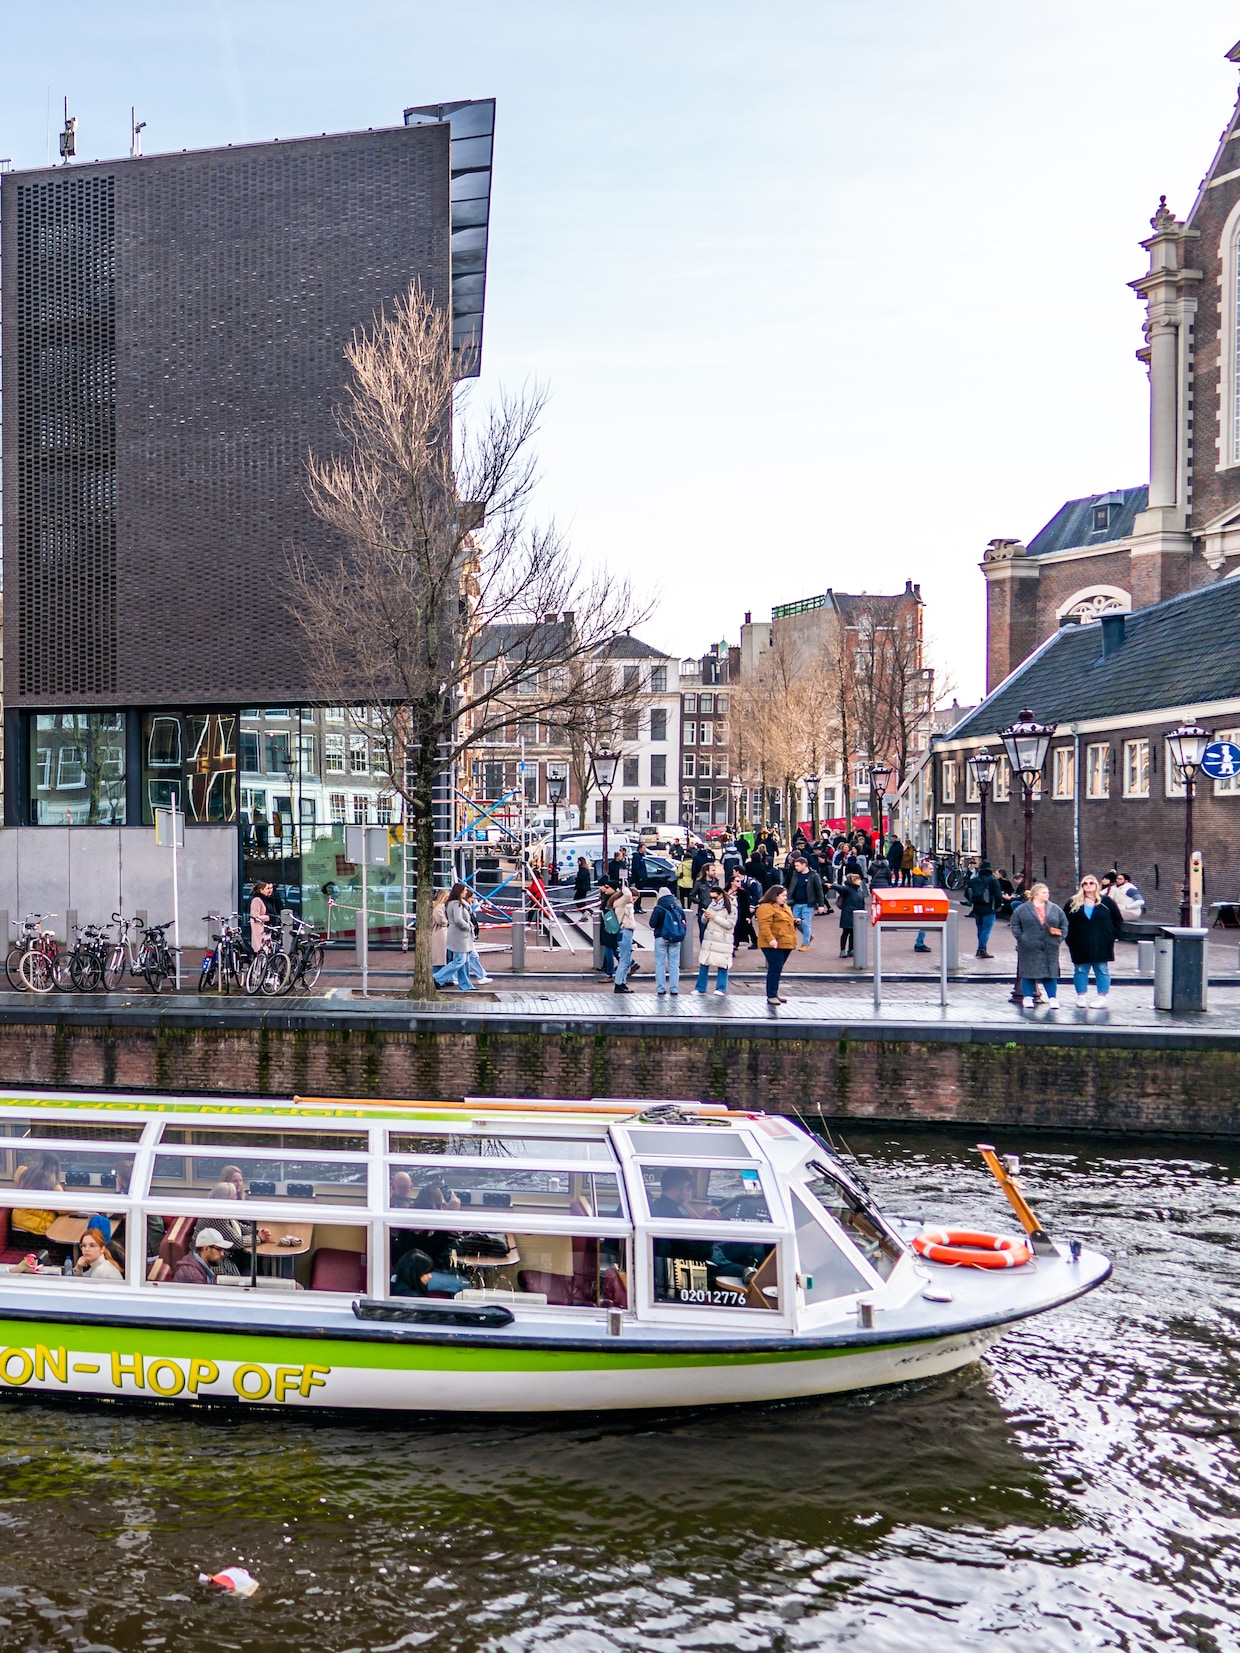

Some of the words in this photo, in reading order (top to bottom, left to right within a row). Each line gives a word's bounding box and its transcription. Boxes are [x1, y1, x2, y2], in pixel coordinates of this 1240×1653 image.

[680, 1289, 747, 1305] 02012776
[110, 1351, 219, 1396] HOP
[233, 1363, 330, 1402] OFF
